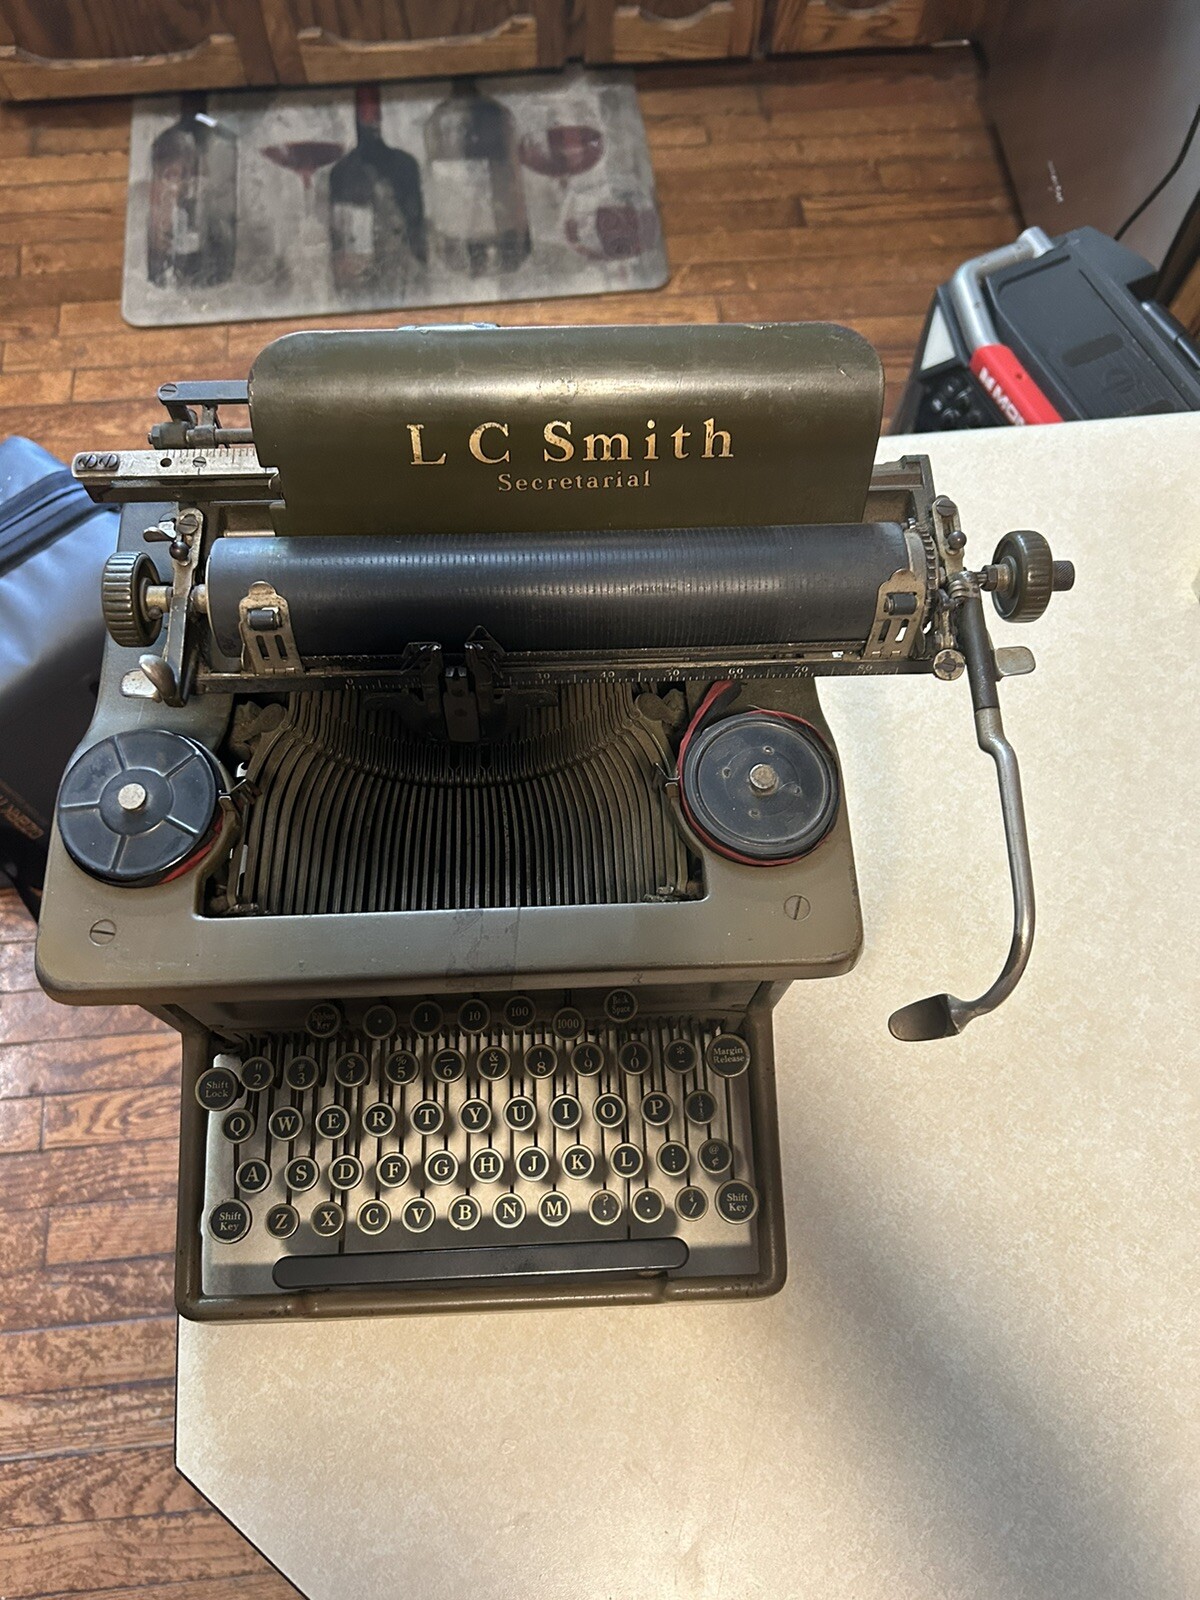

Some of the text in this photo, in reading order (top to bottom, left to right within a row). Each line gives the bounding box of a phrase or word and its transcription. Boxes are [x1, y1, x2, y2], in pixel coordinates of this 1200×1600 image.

[406, 417, 735, 466] L C Smith
[498, 470, 652, 492] Secretarial
[534, 672, 551, 680] 30
[600, 670, 616, 678] 40
[665, 669, 681, 677] 50
[728, 667, 744, 676] 60
[794, 666, 809, 674] 70
[612, 996, 630, 1005] Bk
[423, 1013, 429, 1023] 1
[469, 1011, 481, 1021] 10
[510, 1006, 529, 1017] 100
[612, 1006, 631, 1015] Space
[557, 1018, 580, 1029] 1000
[489, 1051, 499, 1062] &
[713, 1046, 744, 1056] Margin
[395, 1055, 407, 1065] %
[536, 1061, 547, 1074] 8
[584, 1059, 593, 1070] 9
[630, 1057, 639, 1068] 0
[713, 1055, 745, 1064] Release
[397, 1068, 406, 1079] 5
[443, 1065, 453, 1077] 6
[490, 1063, 499, 1075] 7
[206, 1080, 229, 1089] Shift
[253, 1073, 262, 1085] 2
[297, 1072, 306, 1084] 3
[205, 1089, 229, 1098] Lock
[467, 1107, 482, 1123] Y
[512, 1105, 527, 1122] U
[562, 1103, 570, 1119] I
[601, 1103, 617, 1119] O
[649, 1100, 664, 1116] P
[277, 1116, 295, 1131] W
[326, 1113, 341, 1129] E
[372, 1111, 387, 1127] R
[419, 1109, 435, 1125] T
[229, 1117, 246, 1134] Q
[479, 1157, 495, 1174] H
[527, 1155, 538, 1172] J
[571, 1154, 586, 1170] K
[620, 1151, 633, 1167] L
[244, 1166, 260, 1183] A
[296, 1165, 308, 1182] S
[338, 1164, 354, 1180] D
[387, 1162, 401, 1178] F
[434, 1160, 450, 1177] G
[726, 1192, 748, 1202] Shift
[218, 1211, 241, 1221] Shift
[411, 1207, 426, 1223] V
[458, 1204, 472, 1220] B
[502, 1202, 518, 1218] N
[546, 1201, 563, 1217] M
[728, 1203, 748, 1213] Key
[275, 1214, 288, 1230] Z
[321, 1211, 336, 1227] X
[365, 1208, 379, 1225] C
[219, 1222, 239, 1233] Key
